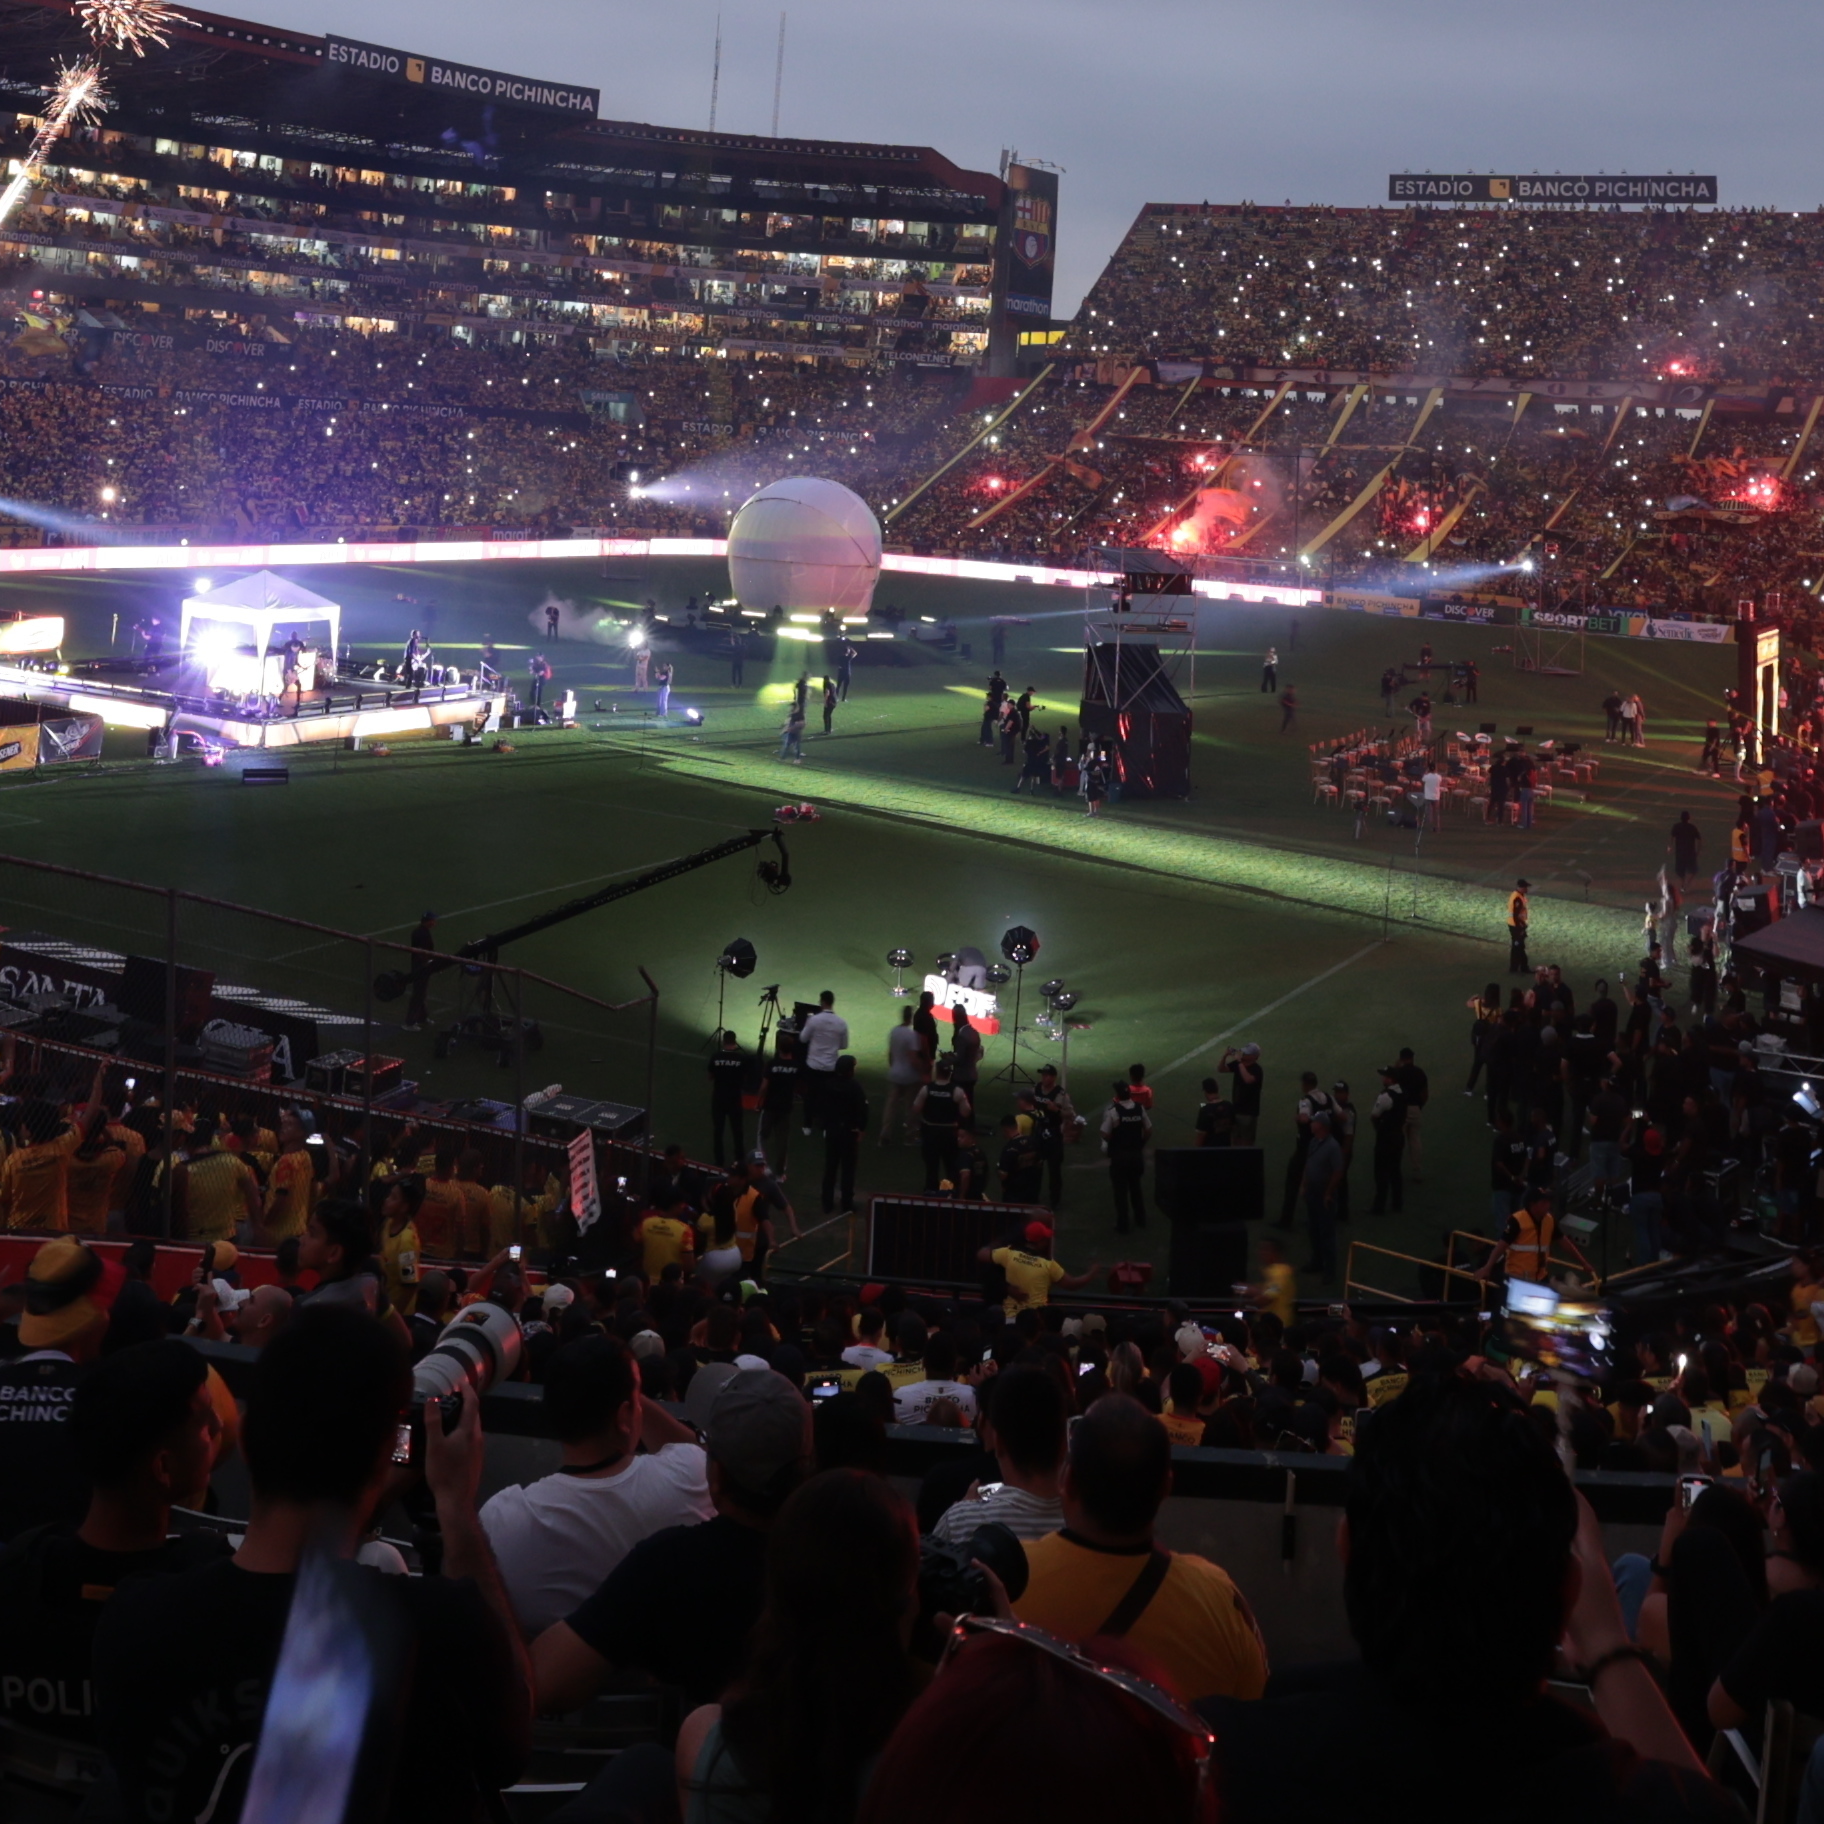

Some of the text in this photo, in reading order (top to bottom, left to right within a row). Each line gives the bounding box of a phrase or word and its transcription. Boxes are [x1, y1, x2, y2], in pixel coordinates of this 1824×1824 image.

[329, 43, 593, 113] ESTADIO BANCO PICHINCHA
[1394, 179, 1711, 199] ESTADIO BANCO PICHINCHA
[0, 229, 53, 245] marathon
[77, 239, 127, 254] marathon
[150, 248, 198, 262] marathon
[221, 256, 267, 270] marathon
[289, 265, 336, 278] marathon
[358, 272, 406, 285] marathon
[429, 280, 478, 292] marathon
[502, 288, 552, 300] marathon
[652, 300, 703, 313] marathon
[1006, 296, 1049, 315] marathon
[727, 308, 779, 319] marathon
[803, 312, 855, 324] marathon
[873, 316, 923, 329] marathon
[932, 321, 983, 333] marathon
[113, 331, 174, 349] DISCOVER
[206, 339, 265, 356] DISCOVER
[883, 351, 952, 364] TELCONET.NET
[298, 398, 343, 411] ESTADIO
[1336, 596, 1415, 611] BANCO PICHINCHA
[1445, 603, 1495, 619] DISCOVER
[1532, 610, 1618, 632] SPORTBET
[1656, 622, 1694, 640] Semedic
[714, 1059, 742, 1068] STAFF
[772, 1065, 799, 1074] STAFF
[1121, 1114, 1142, 1123] POLICIA
[883, 1366, 926, 1376] PICHINCH
[1168, 1431, 1196, 1445] ANCO
[1, 1674, 94, 1718] POLI
